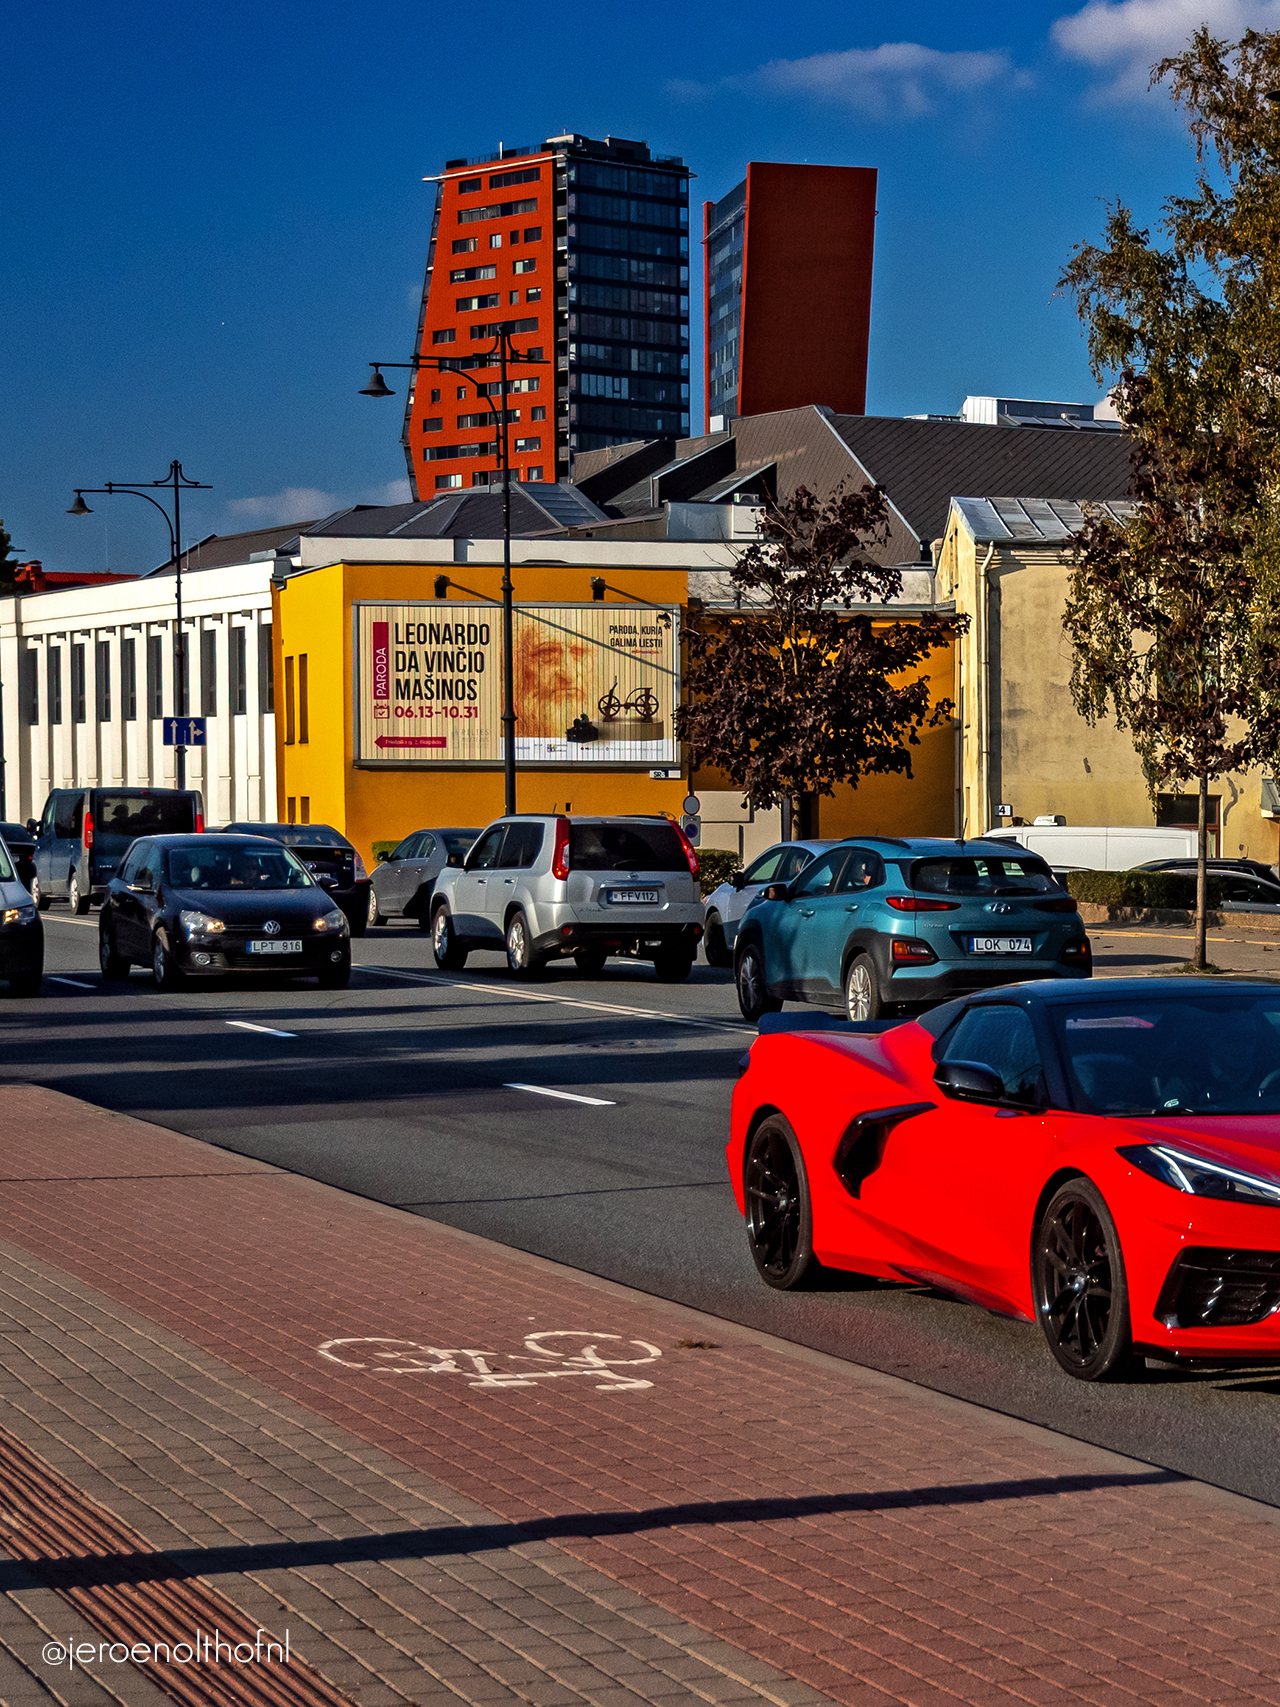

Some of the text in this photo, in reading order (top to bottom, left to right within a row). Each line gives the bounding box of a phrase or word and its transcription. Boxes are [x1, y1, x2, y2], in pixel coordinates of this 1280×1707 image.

[395, 622, 490, 646] LEONARDO
[609, 625, 663, 636] PARODA, KURIĄ
[610, 638, 662, 648] GALIMA LIESTI!
[395, 646, 485, 673] DA VINČIO
[376, 647, 387, 696] PARODA
[395, 673, 478, 701] MAŠINOS
[998, 805, 1006, 814] 4
[253, 941, 301, 951] LPT 916
[975, 939, 1031, 951] LOK 074
